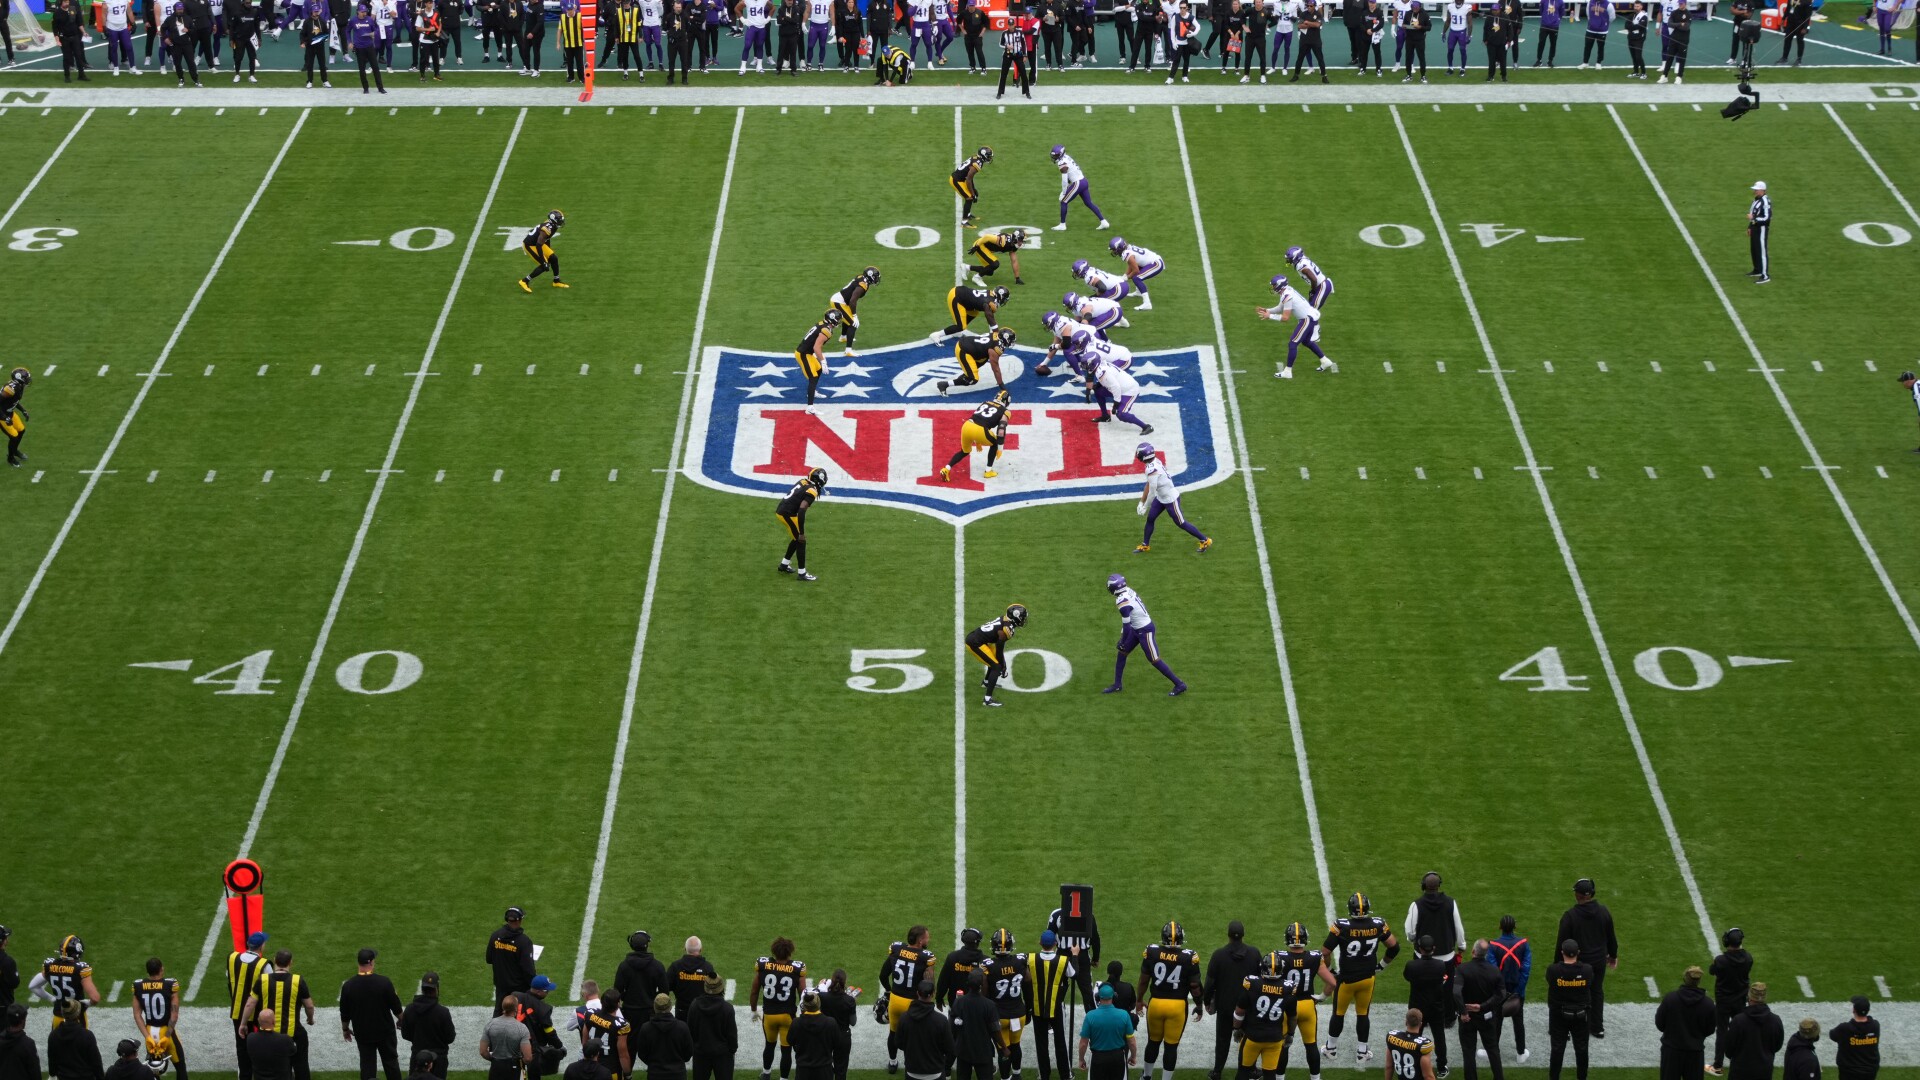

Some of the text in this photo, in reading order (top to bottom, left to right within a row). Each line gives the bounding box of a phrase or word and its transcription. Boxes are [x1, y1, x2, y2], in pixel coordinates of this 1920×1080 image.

[112, 5, 126, 15] 67
[380, 9, 391, 19] 12
[750, 7, 763, 17] 84
[814, 4, 826, 15] 81
[916, 7, 927, 17] 41
[995, 18, 1005, 28] G
[1451, 14, 1463, 25] 31
[1764, 17, 1772, 27] G
[752, 409, 1167, 493] NFL
[1069, 891, 1082, 918] 1
[1346, 938, 1379, 957] 97
[1159, 951, 1178, 962] BLACK
[765, 962, 794, 974] HEYWARD
[955, 962, 973, 972] Steel
[1293, 958, 1304, 967] LEE
[49, 965, 75, 974] HOLCOMB
[893, 959, 916, 988] 51
[1001, 965, 1015, 976] LEAL
[1153, 962, 1182, 990] 94
[1287, 968, 1311, 992] 91
[50, 975, 76, 1000] 55
[142, 982, 164, 991] WILSON
[763, 973, 794, 1002] 83
[995, 974, 1024, 999] 98
[1556, 978, 1586, 987] Steelers
[1262, 984, 1283, 995] EKUALE
[142, 992, 166, 1020] 10
[1256, 995, 1284, 1021] 96
[1849, 1036, 1878, 1046] Steelers
[1391, 1049, 1416, 1080] 88
